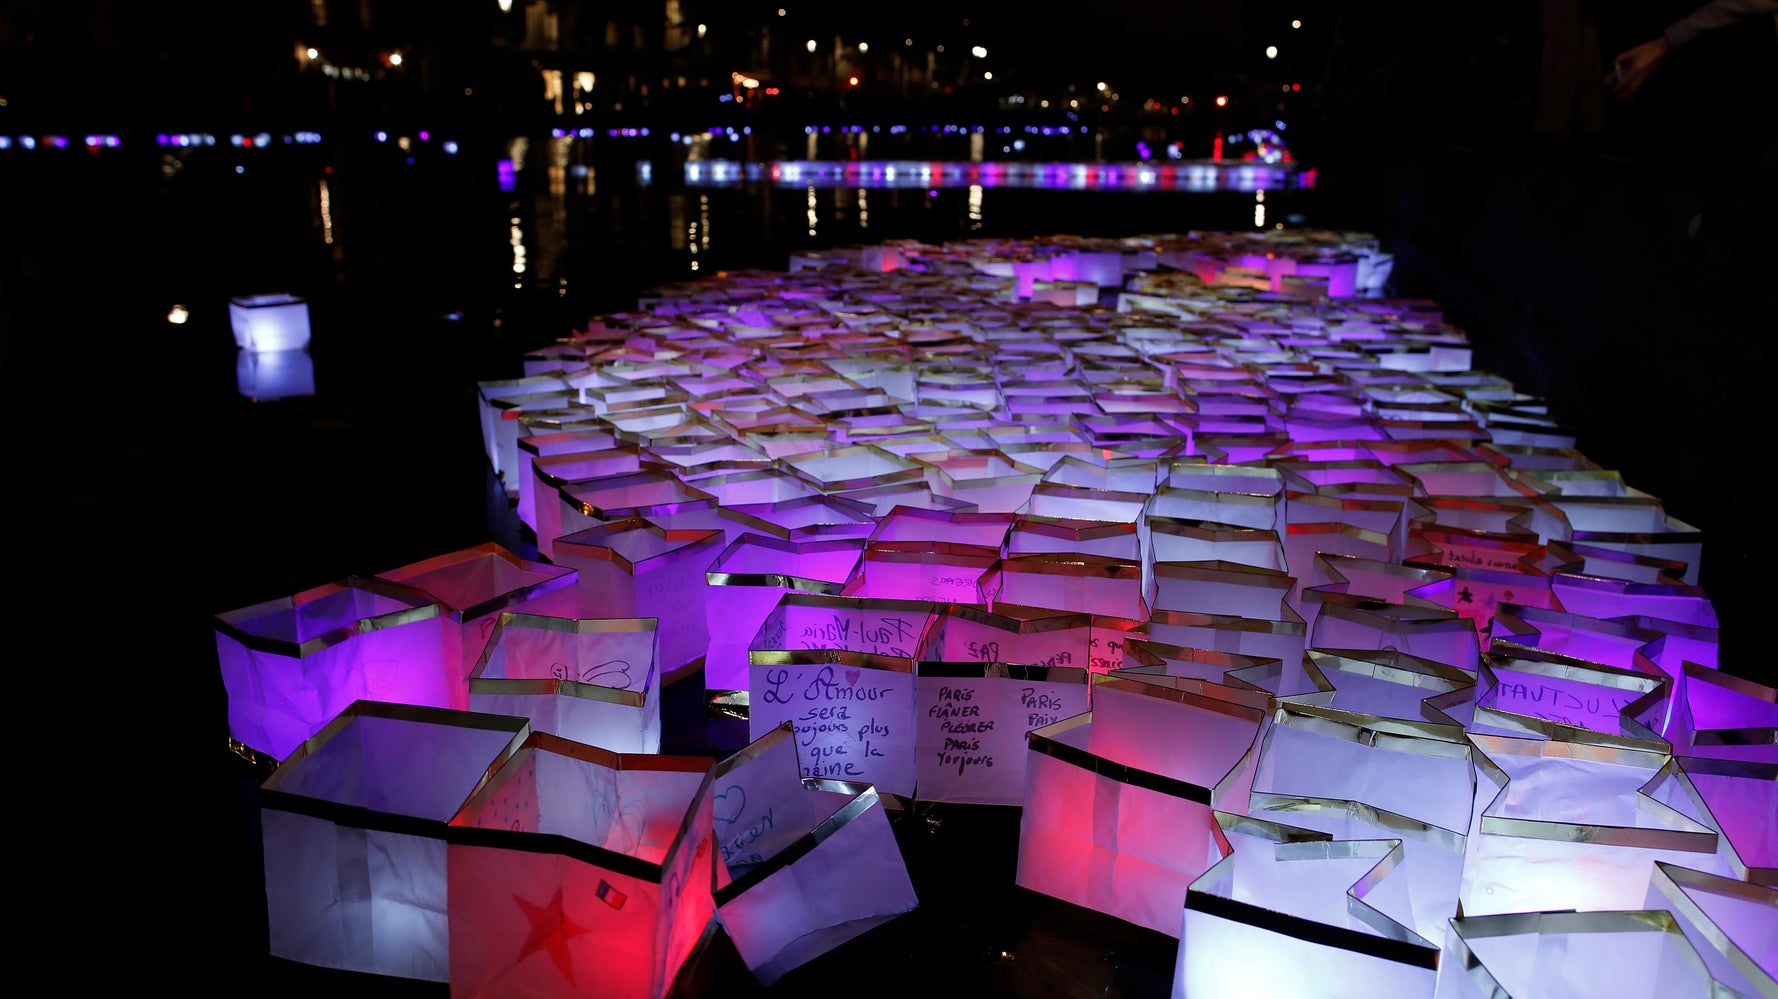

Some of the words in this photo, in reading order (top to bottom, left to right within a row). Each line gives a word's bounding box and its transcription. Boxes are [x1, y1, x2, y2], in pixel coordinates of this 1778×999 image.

[799, 706, 851, 720] sera
[780, 721, 849, 747] oujours
[858, 718, 889, 739] plus
[811, 745, 847, 767] que
[865, 741, 884, 757] la
